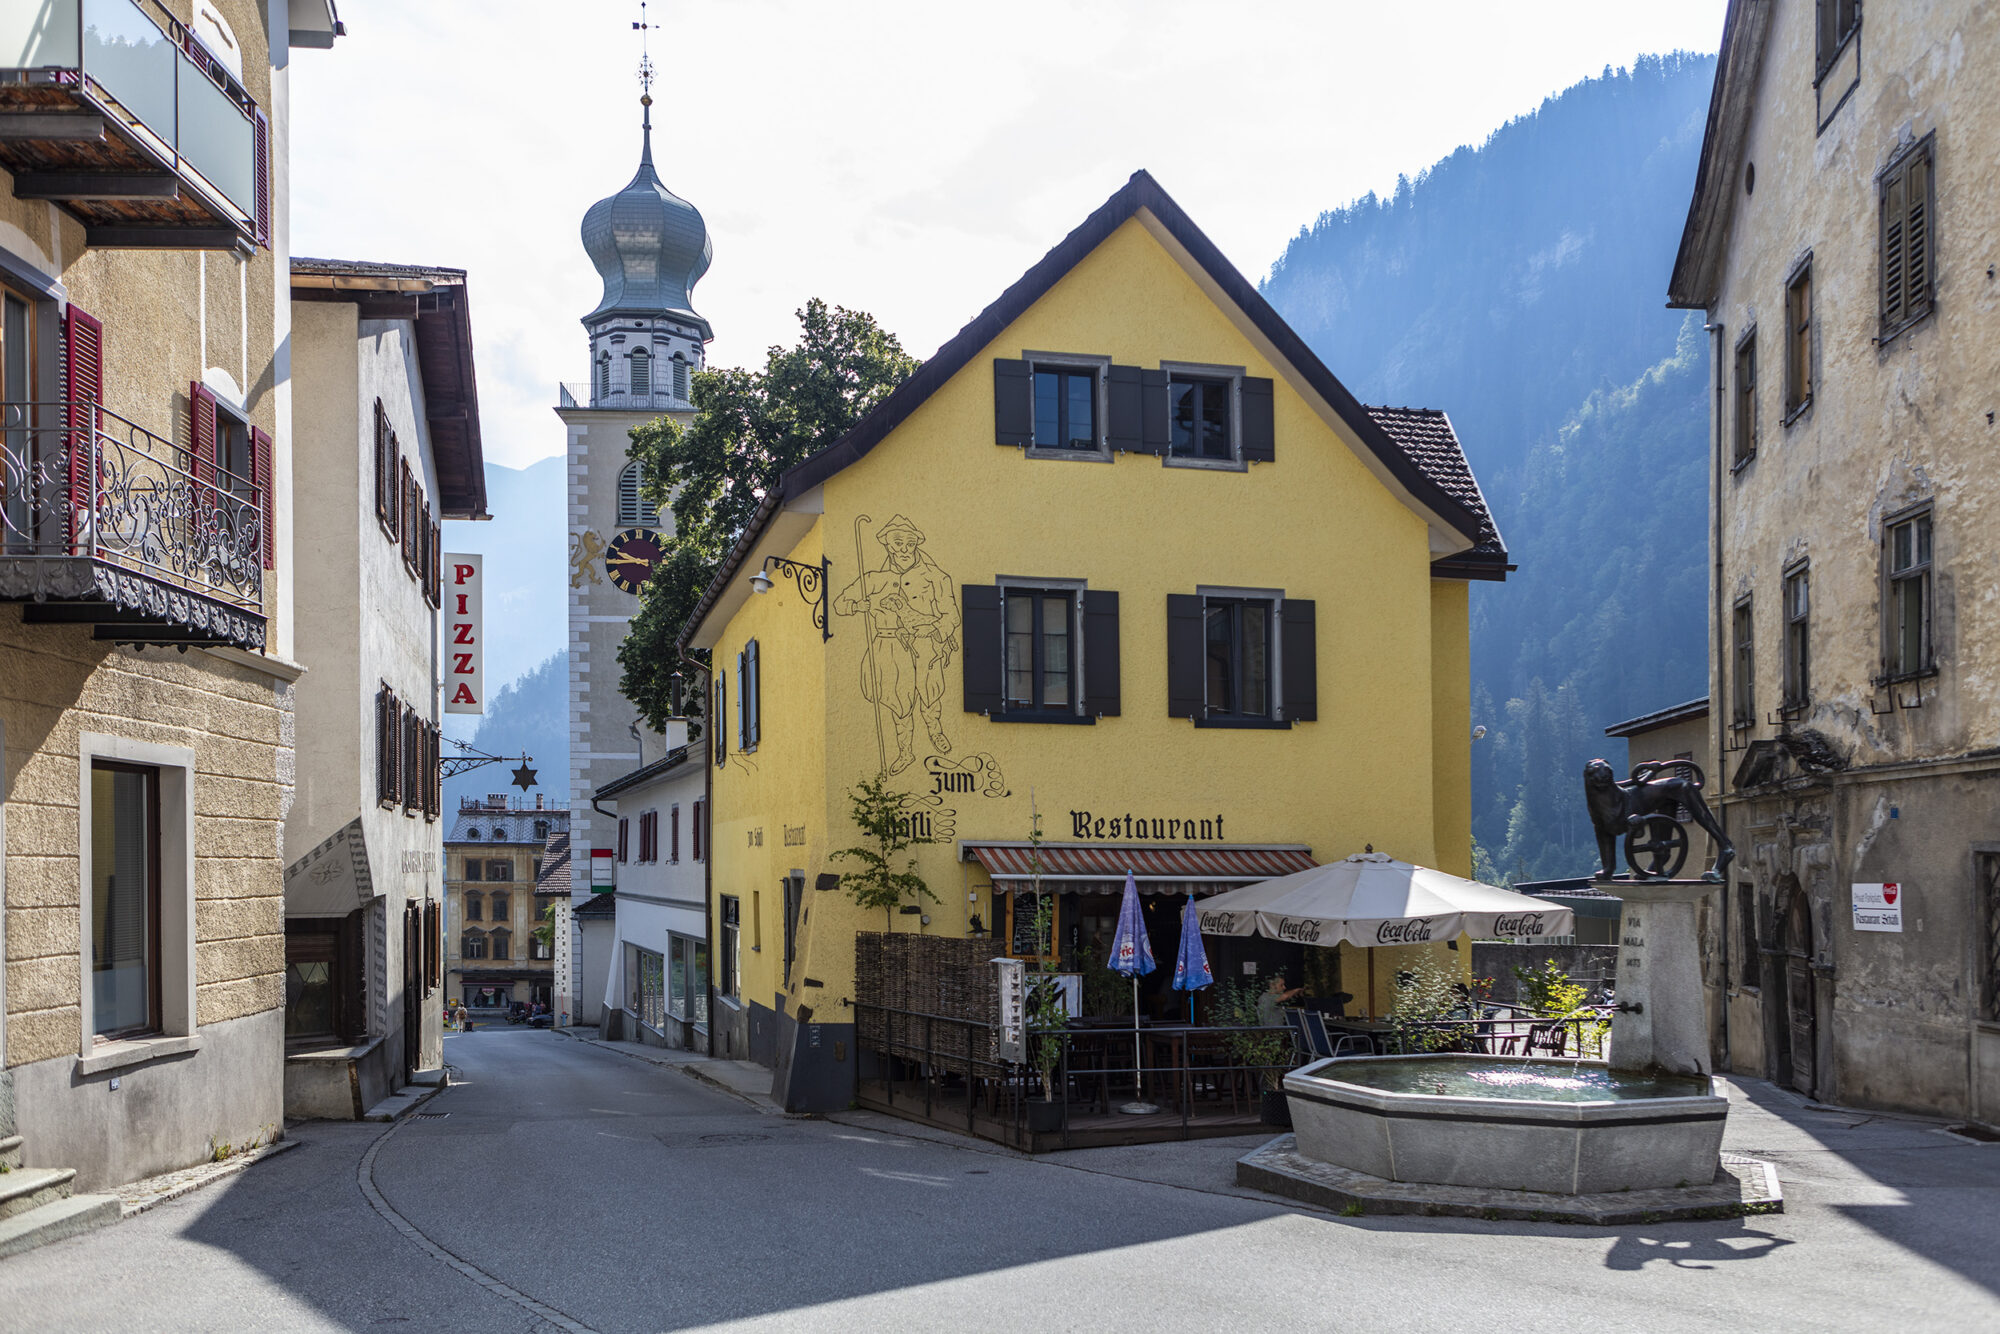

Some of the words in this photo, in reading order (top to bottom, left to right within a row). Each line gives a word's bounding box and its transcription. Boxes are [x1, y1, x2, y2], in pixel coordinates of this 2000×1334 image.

[451, 564, 477, 704] PIZZA
[863, 810, 932, 847] häfli
[1069, 809, 1224, 840] Restaurant
[1628, 918, 1640, 927] VIA
[1855, 913, 1880, 924] Restaurant
[1624, 937, 1644, 946] MALA
